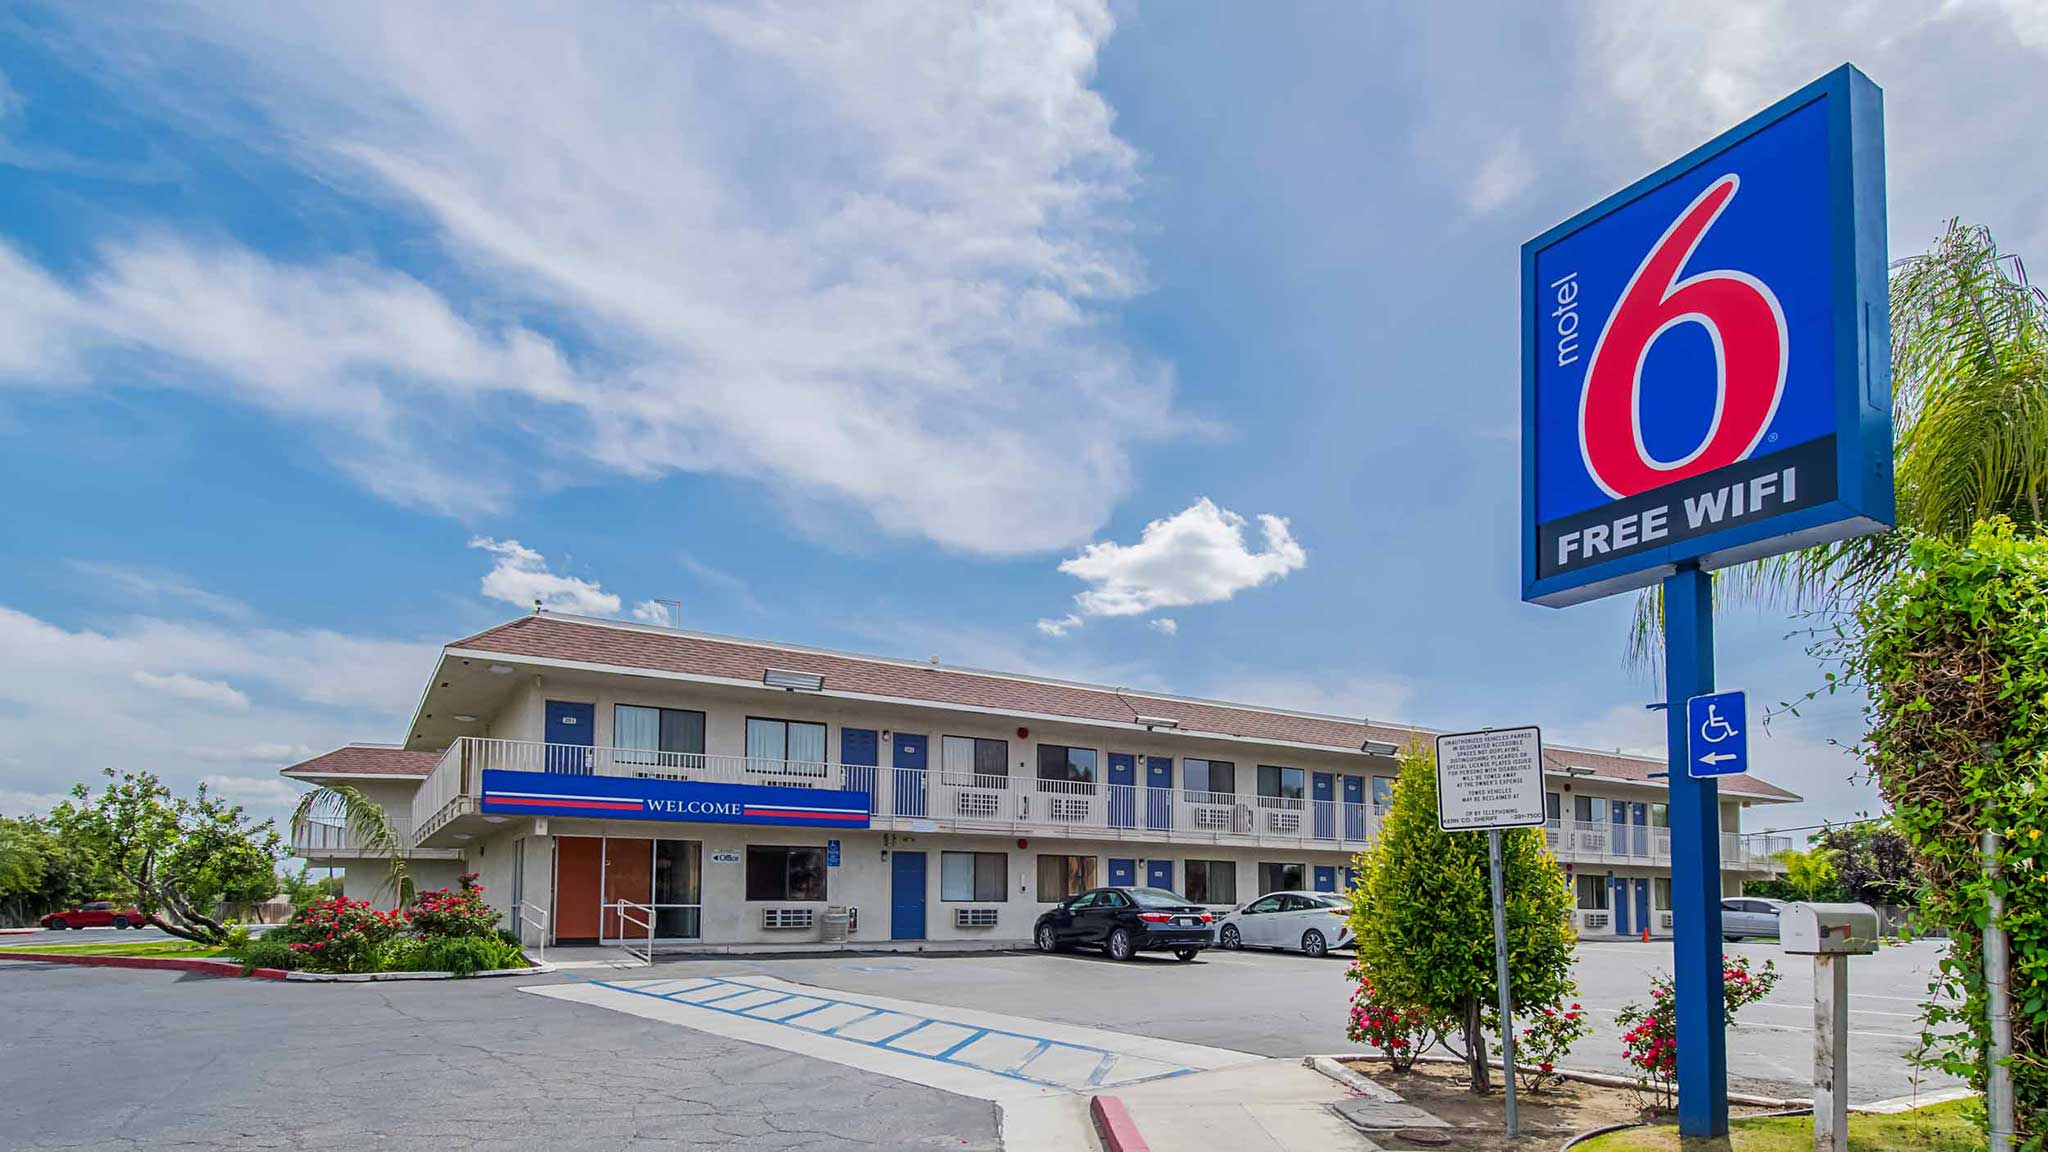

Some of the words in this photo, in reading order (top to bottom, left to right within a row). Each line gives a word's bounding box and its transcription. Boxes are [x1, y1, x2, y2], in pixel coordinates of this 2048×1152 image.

[1551, 272, 1578, 367] motel
[1578, 173, 1789, 500] 6
[1557, 504, 1669, 566] FREE
[1684, 467, 1796, 529] WIFI
[647, 799, 741, 815] WELCOME
